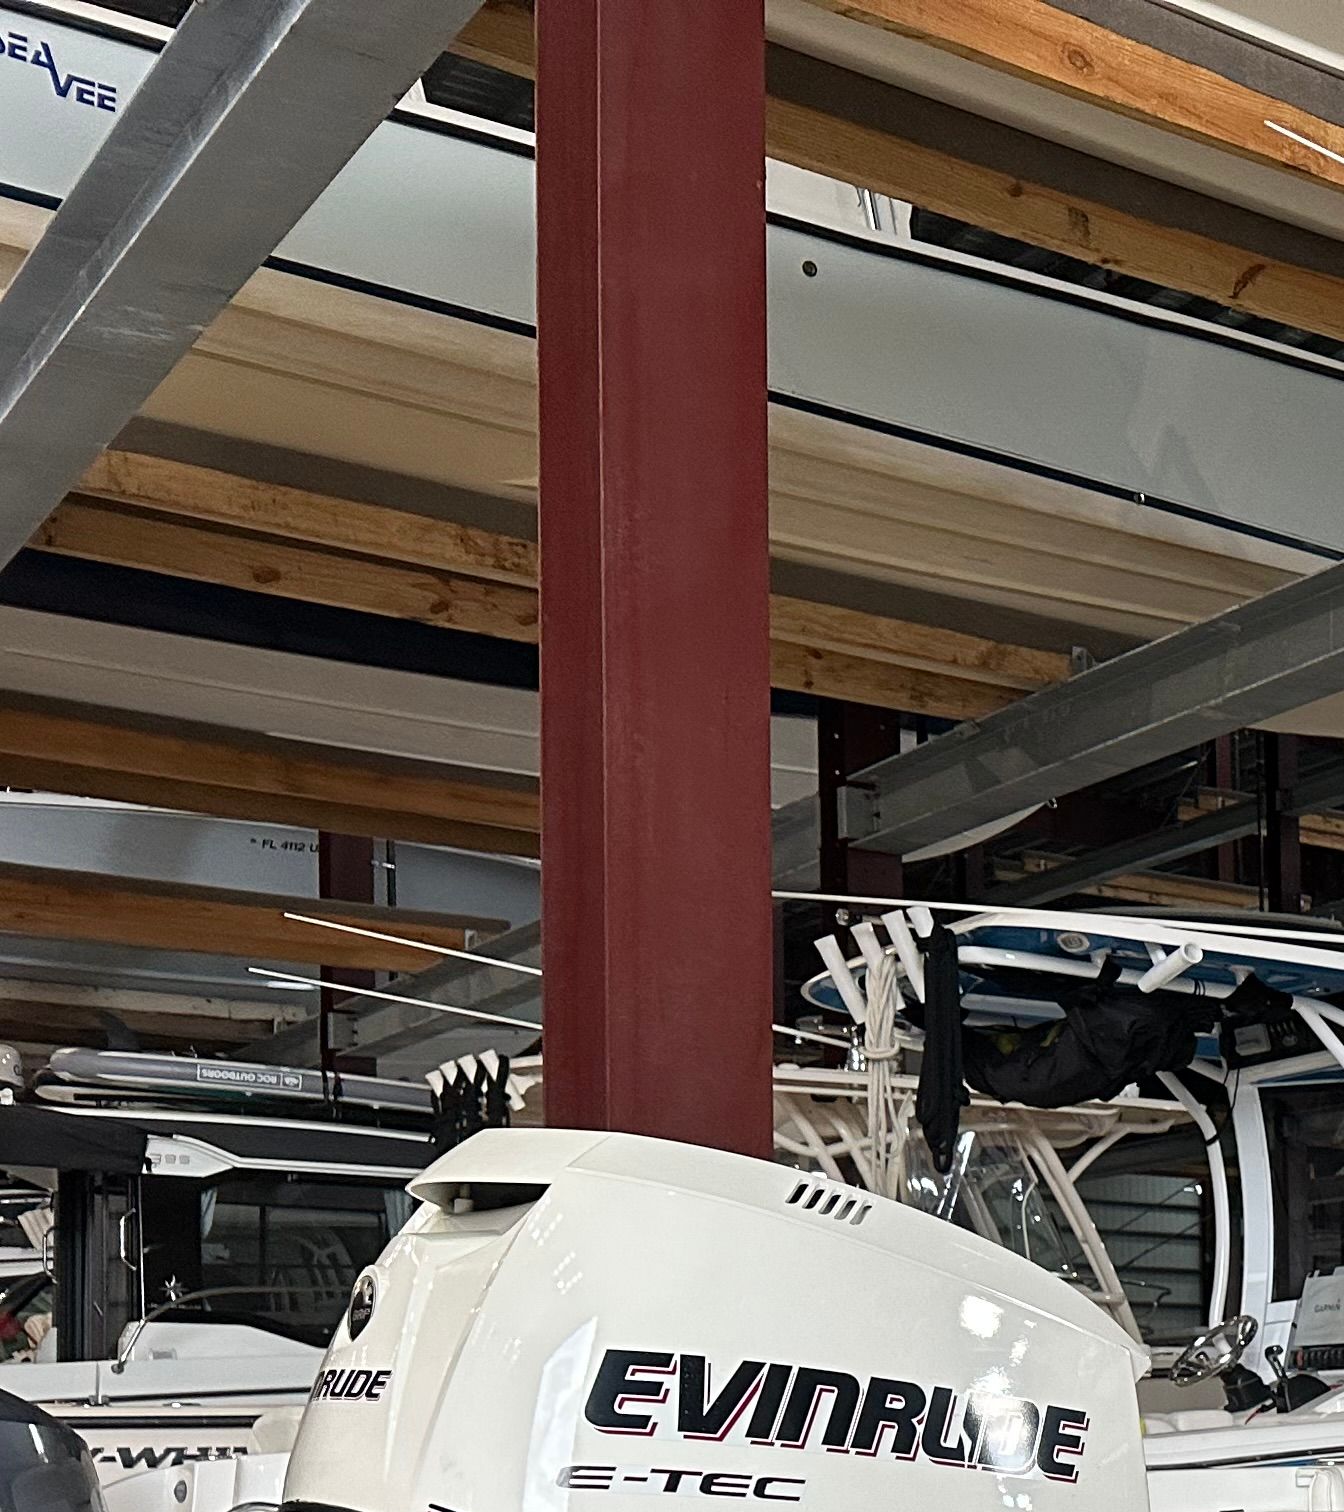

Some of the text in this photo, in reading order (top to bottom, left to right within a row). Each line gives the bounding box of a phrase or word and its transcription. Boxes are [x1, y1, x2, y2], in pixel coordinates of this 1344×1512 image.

[262, 839, 277, 850] FL
[201, 1068, 278, 1084] ROC OUTDOORS
[584, 1348, 1089, 1484] EVINRUDE
[558, 1464, 807, 1503] E-TEC
